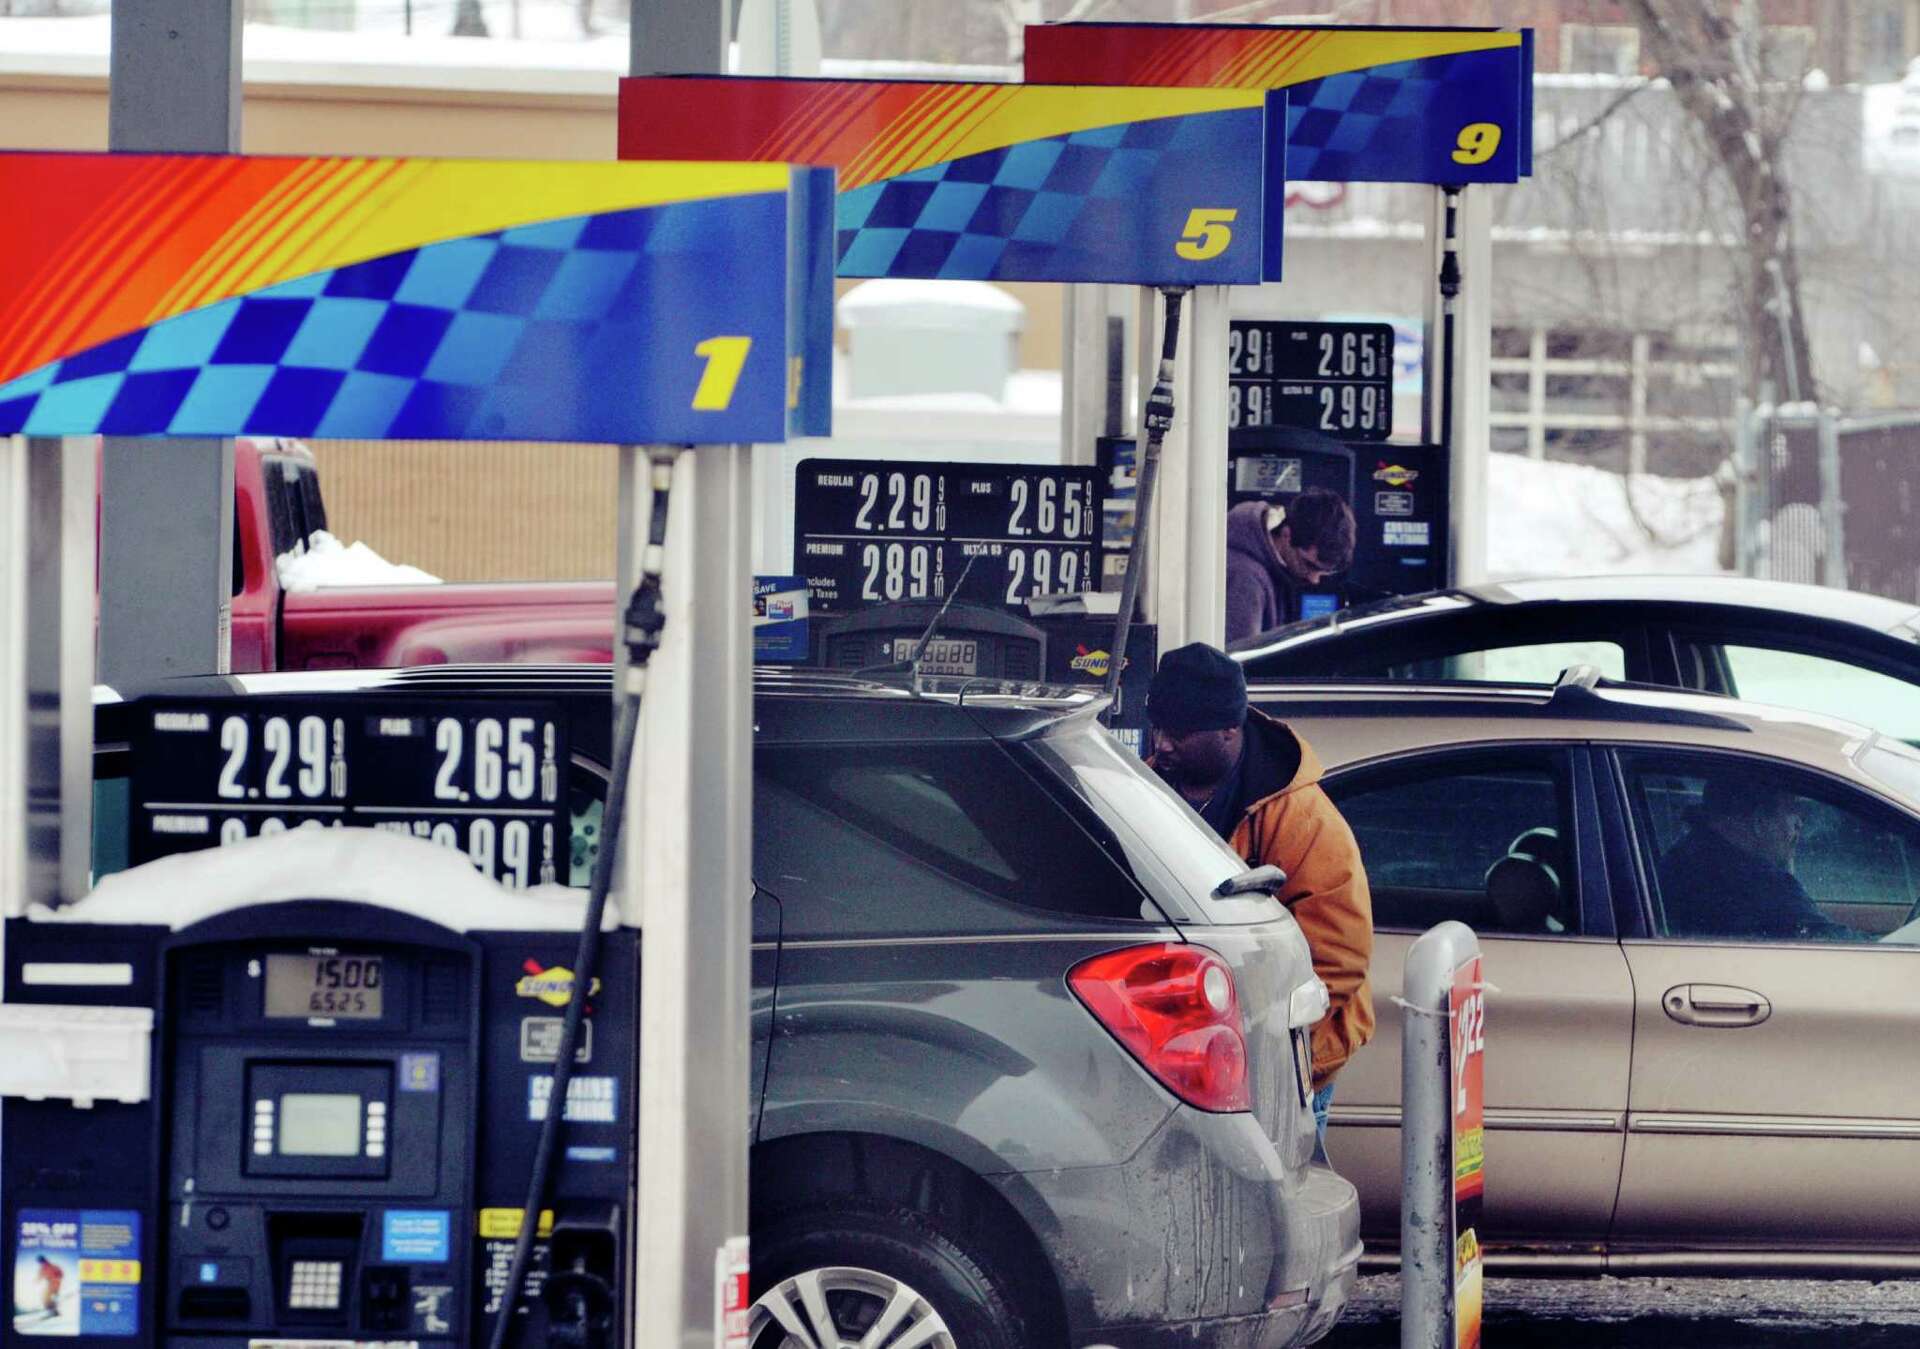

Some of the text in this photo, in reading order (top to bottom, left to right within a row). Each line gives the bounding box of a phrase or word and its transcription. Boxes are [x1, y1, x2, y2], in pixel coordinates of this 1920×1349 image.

[1452, 122, 1502, 165] 9
[1175, 208, 1238, 261] 5
[691, 335, 753, 411] 1
[1229, 329, 1262, 374] 29
[1318, 332, 1376, 377] 2.65
[1229, 385, 1263, 429] 89
[1320, 386, 1376, 430] 2.99
[817, 472, 932, 532] REGULAR 2.29
[971, 477, 1083, 539] PLUS 2.65
[754, 583, 777, 593] SAVE
[806, 543, 929, 600] PREMIUM 2.89
[807, 576, 836, 587] ncludes
[816, 588, 839, 599] Taxes
[963, 544, 988, 556] ULTRA
[1006, 548, 1078, 605] 2.99
[218, 715, 327, 799] 2.29
[434, 717, 536, 802] 2.65
